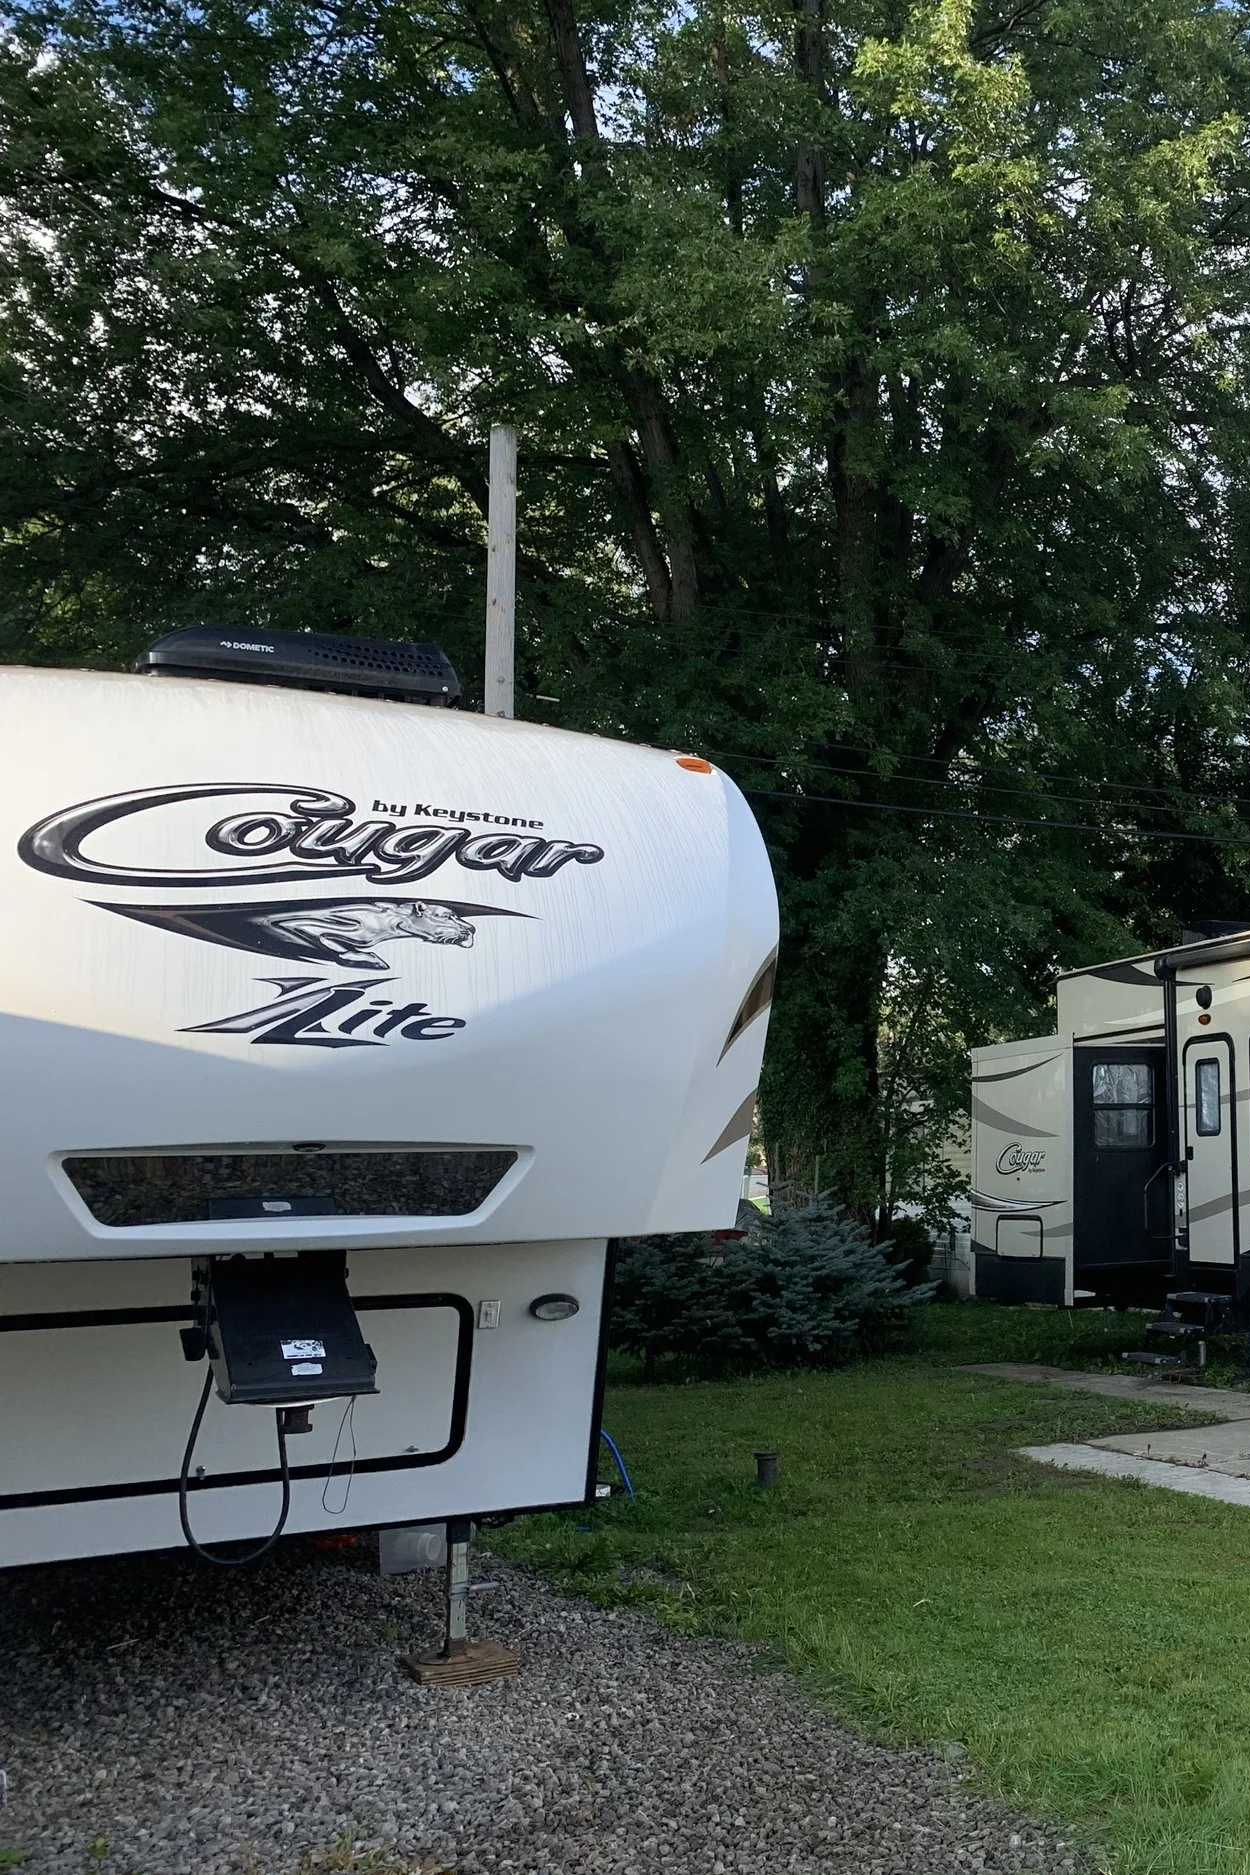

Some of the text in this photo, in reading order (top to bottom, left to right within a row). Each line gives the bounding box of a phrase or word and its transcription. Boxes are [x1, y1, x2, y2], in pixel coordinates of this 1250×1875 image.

[232, 641, 275, 653] DOMETIC
[372, 800, 544, 830] by Keystone
[17, 782, 605, 887] Cougar
[996, 1142, 1046, 1175] Cougar
